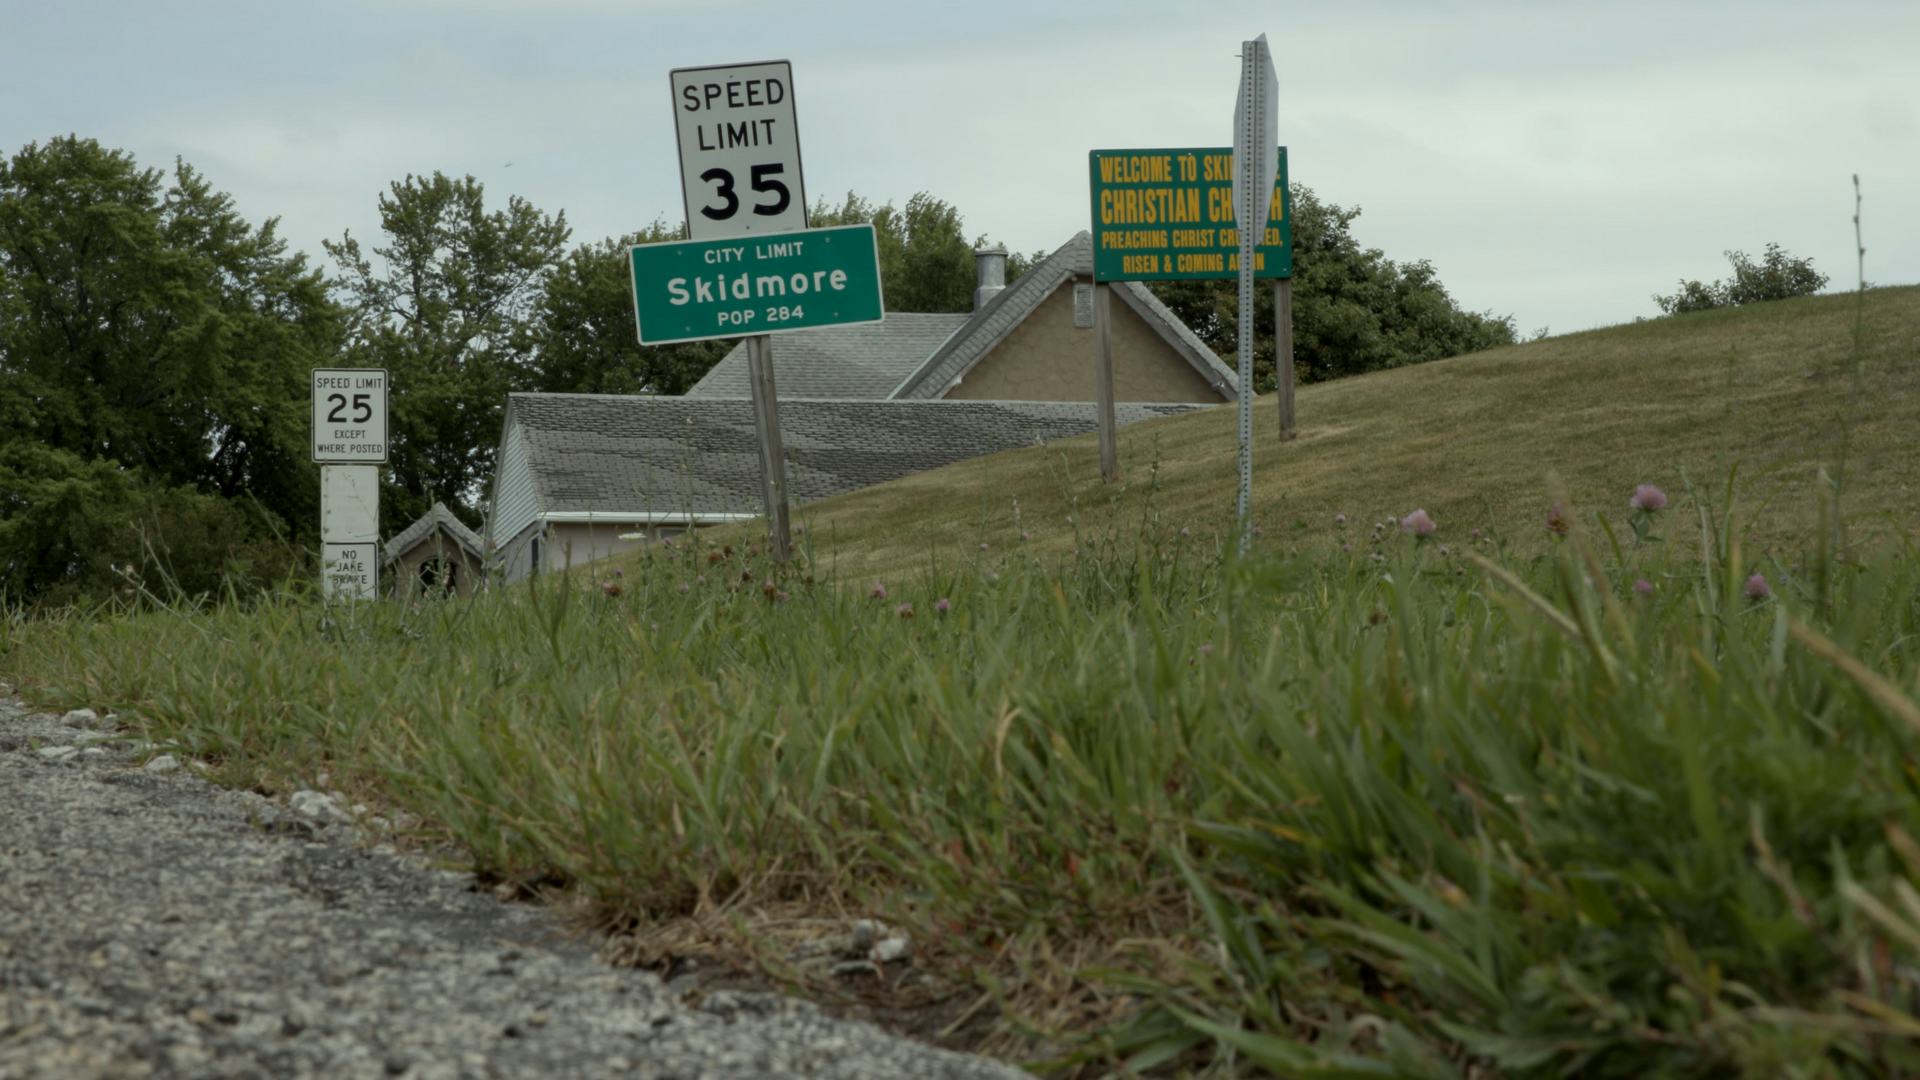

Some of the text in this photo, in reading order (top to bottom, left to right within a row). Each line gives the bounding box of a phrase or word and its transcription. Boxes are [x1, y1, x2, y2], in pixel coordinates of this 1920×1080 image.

[683, 79, 784, 111] SPEED
[697, 119, 776, 151] LIMIT
[1100, 155, 1172, 183] WELCOME
[1177, 155, 1197, 182] TO
[700, 163, 791, 221] 35
[1101, 187, 1282, 224] CHRISTIAN CHH
[1102, 230, 1168, 249] PREACHING
[1172, 229, 1215, 247] CHRIST
[704, 241, 804, 264] CITY LIMIT
[1123, 255, 1158, 273] RISEN
[1163, 255, 1172, 273] &
[1177, 254, 1224, 271] COMING
[667, 268, 848, 306] Skidmore
[717, 305, 804, 326] POP 284
[317, 378, 382, 388] SPEED LIMIT
[327, 393, 372, 423] 25
[334, 429, 366, 440] EXCEPT
[317, 444, 383, 454] WHERE POSTED
[342, 550, 357, 559] NO
